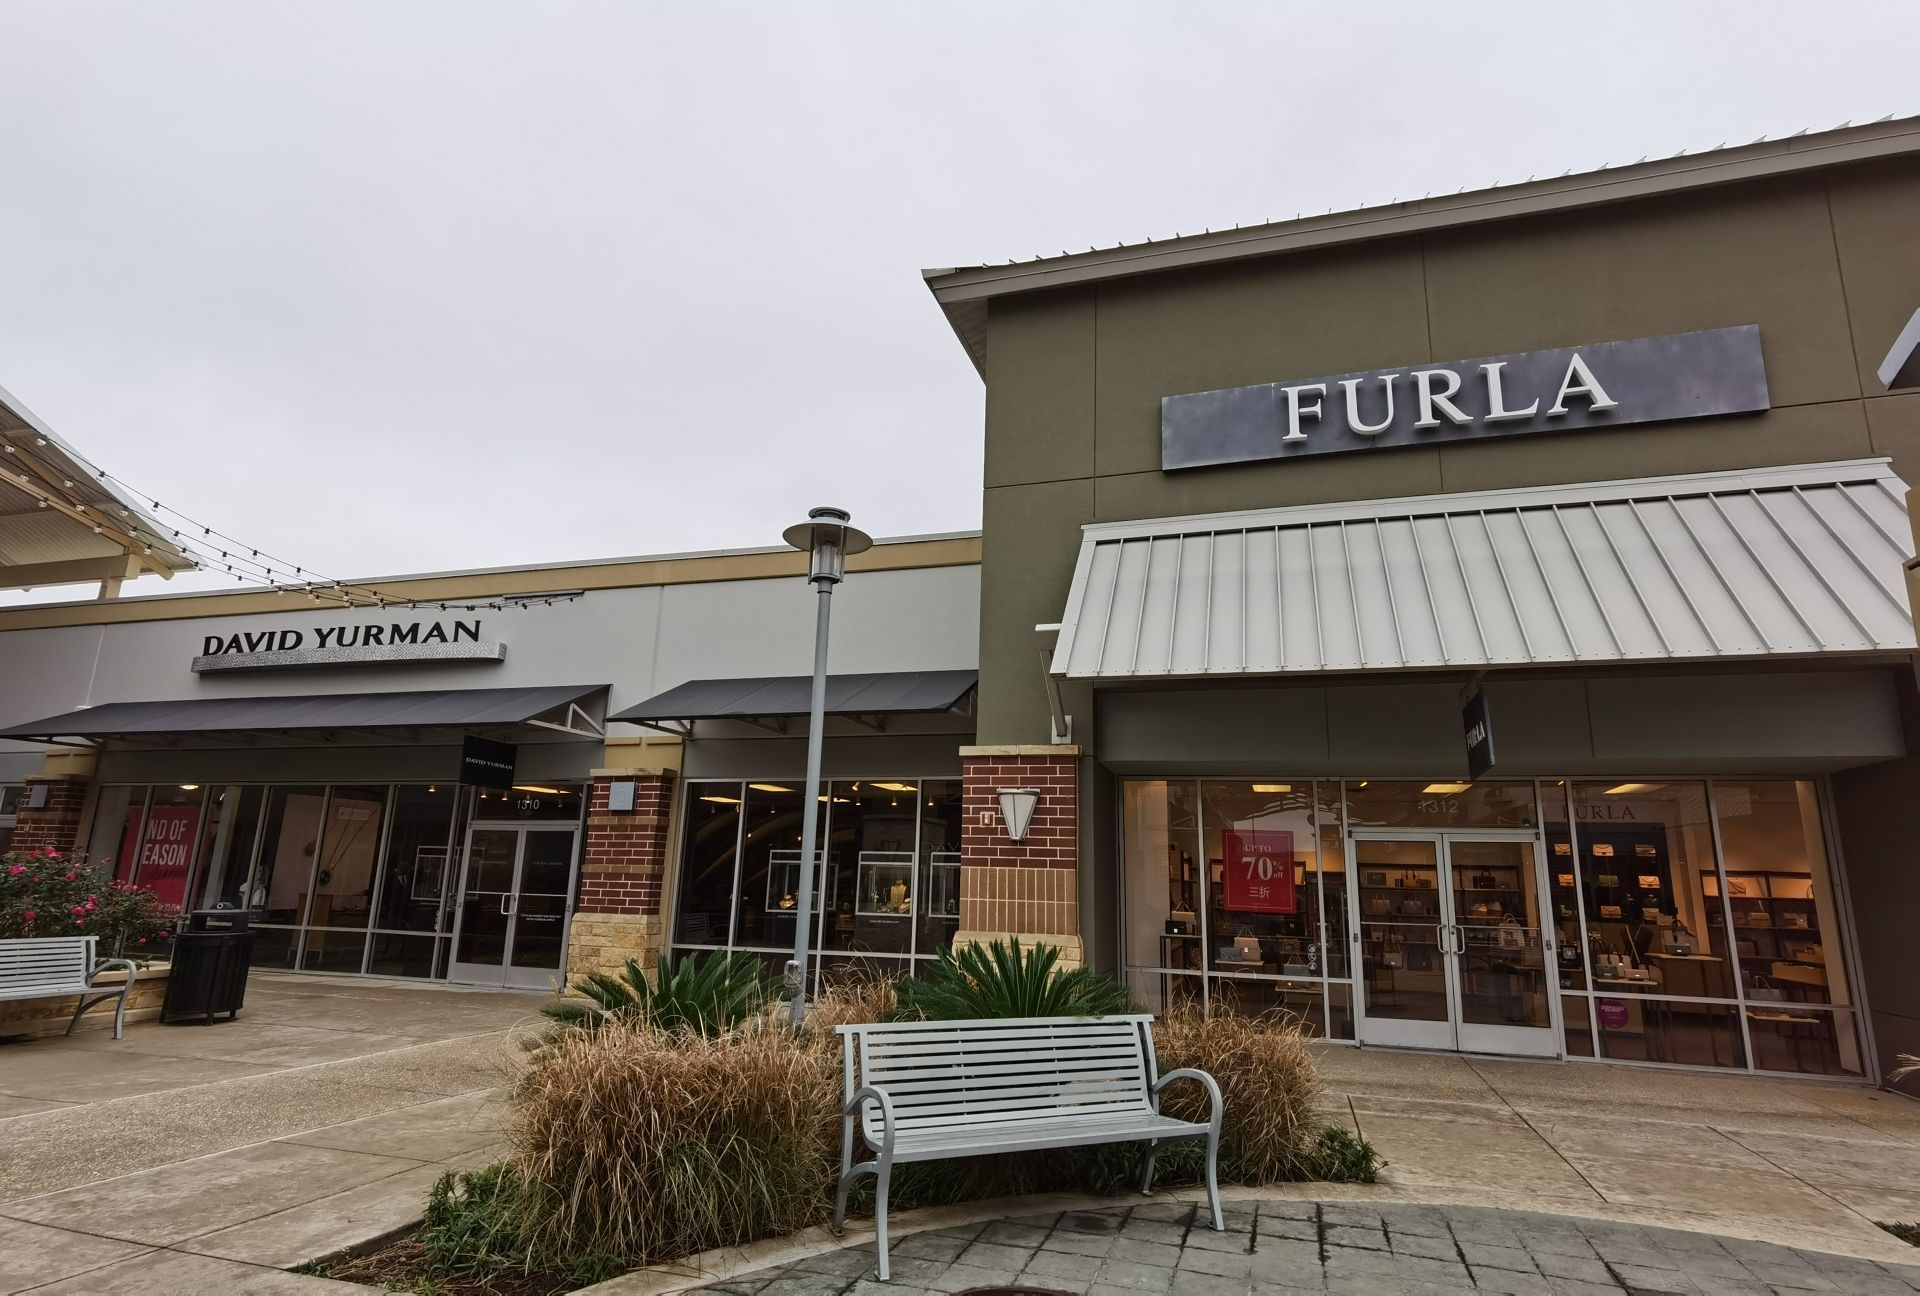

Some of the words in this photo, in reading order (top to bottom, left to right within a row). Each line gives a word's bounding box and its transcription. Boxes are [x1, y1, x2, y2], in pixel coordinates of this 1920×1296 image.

[1281, 353, 1619, 443] FURLA
[202, 629, 303, 656] DAVID
[313, 620, 482, 649] YURMAN
[1467, 721, 1486, 751] FURLA
[466, 757, 486, 765] DAVID
[487, 761, 513, 770] YURMAN
[516, 800, 540, 810] 1310
[1420, 800, 1459, 813] 1312
[147, 820, 167, 840] ND
[169, 820, 188, 841] OF
[142, 844, 188, 866] EASON
[1249, 886, 1270, 898] 三折
